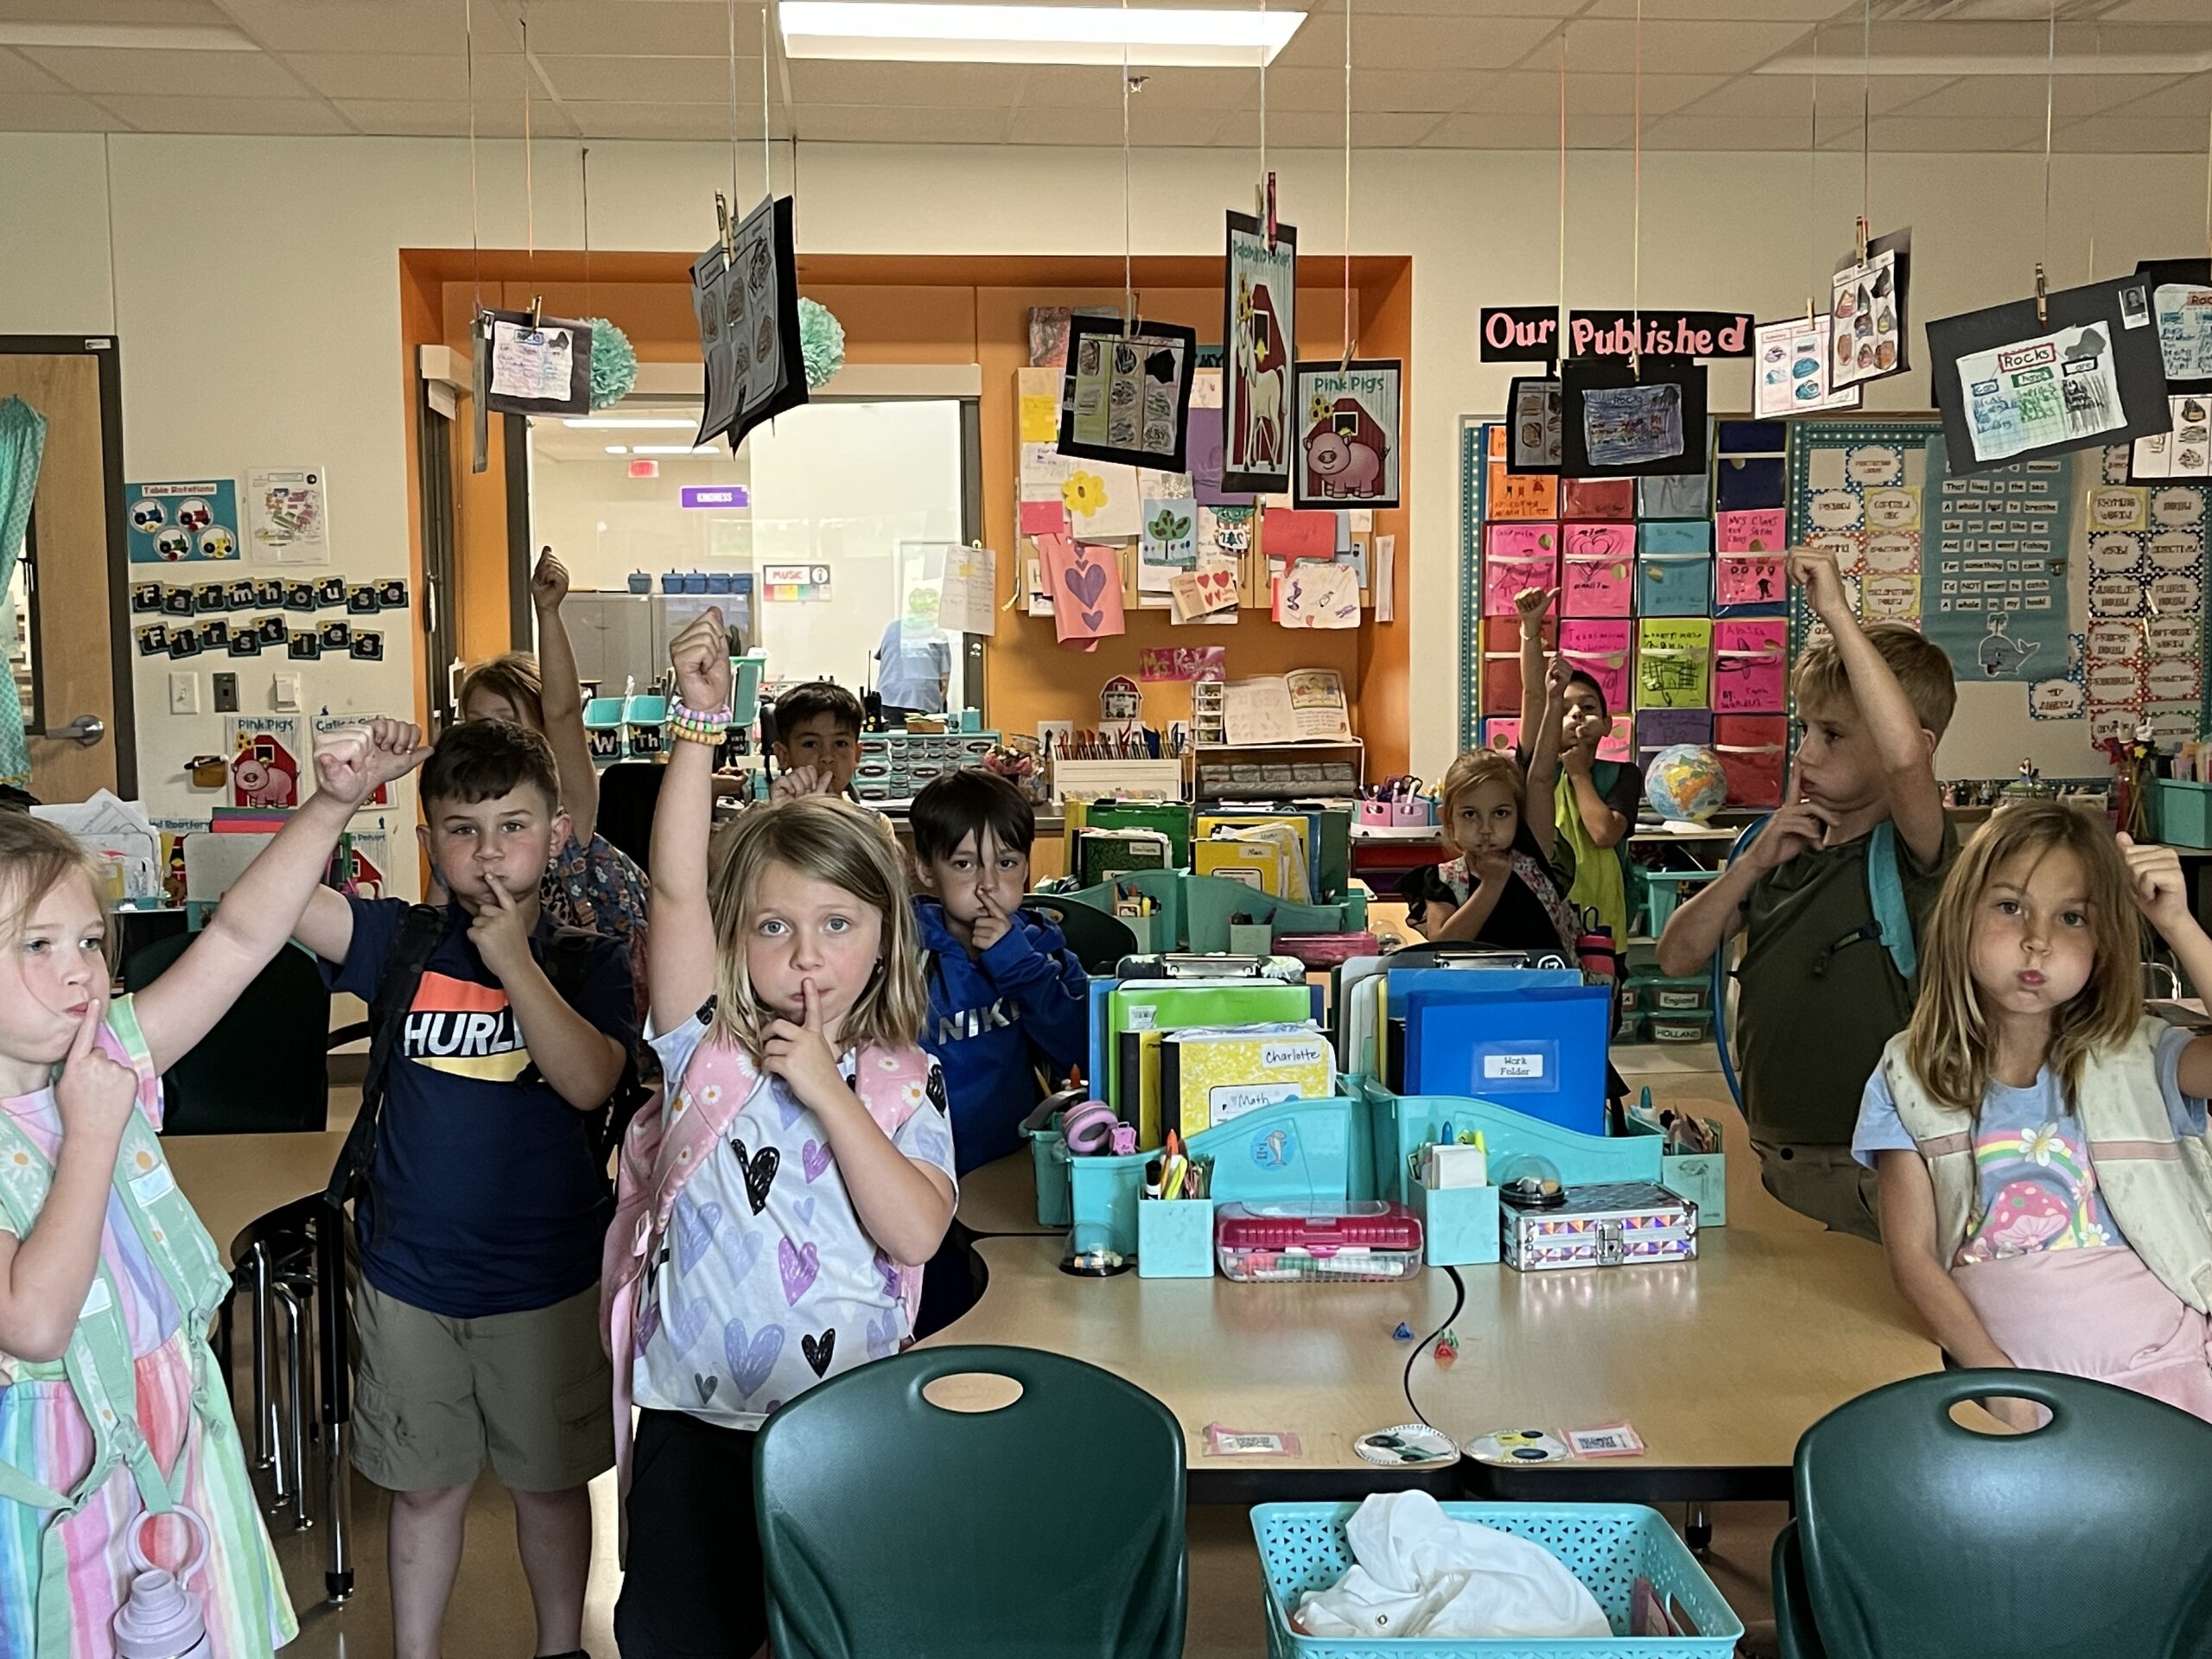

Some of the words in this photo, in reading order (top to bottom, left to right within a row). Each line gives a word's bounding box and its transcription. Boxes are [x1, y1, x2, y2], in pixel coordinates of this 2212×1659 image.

[1485, 312, 1555, 348] Our
[1573, 316, 1749, 356] Published
[2004, 349, 2050, 367] Rocks
[1314, 377, 1347, 391] Pink
[1351, 375, 1384, 393] Pigs
[2023, 542, 2049, 551] fishing
[772, 571, 802, 580] MUSIC
[143, 585, 401, 609] Farmhouse
[149, 623, 373, 652] Firsties
[238, 719, 264, 730] Pink
[267, 719, 294, 731] Pigs
[594, 736, 614, 753] W
[639, 735, 658, 747] Th
[1663, 995, 1696, 1007] England
[1657, 1027, 1699, 1038] HOLLAND
[1266, 1049, 1320, 1064] Charlotte
[1504, 1057, 1527, 1065] Work
[1500, 1067, 1530, 1076] Folder
[1238, 1093, 1270, 1108] Math
